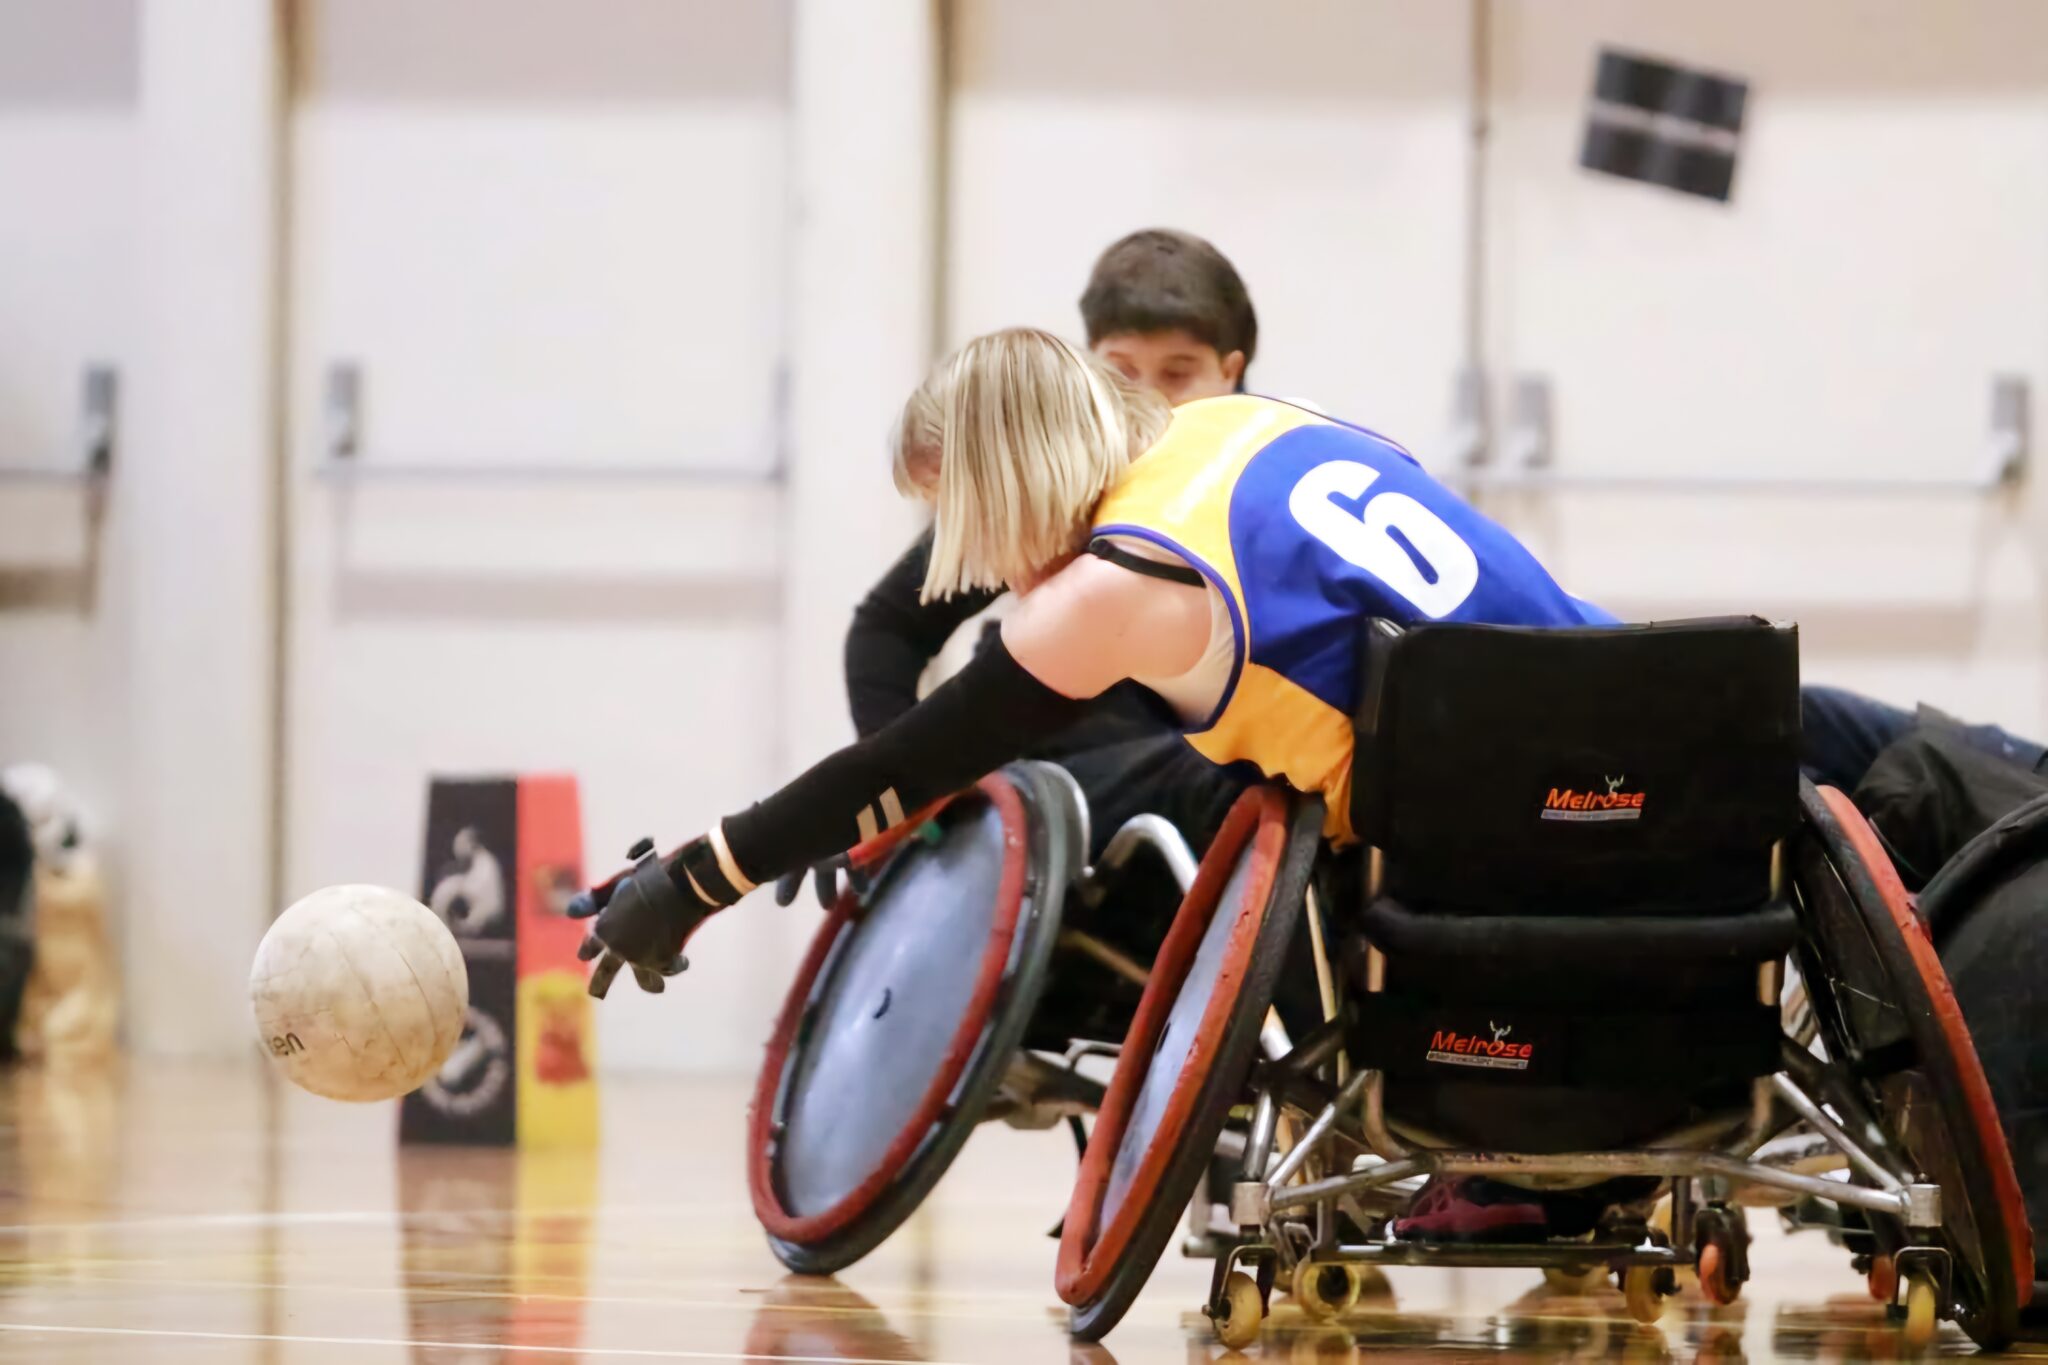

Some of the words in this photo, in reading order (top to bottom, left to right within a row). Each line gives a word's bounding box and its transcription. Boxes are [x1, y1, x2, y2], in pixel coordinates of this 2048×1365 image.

[1288, 459, 1479, 619] 6
[1545, 787, 1646, 809] Melrose
[1430, 1031, 1533, 1058] Melrose
